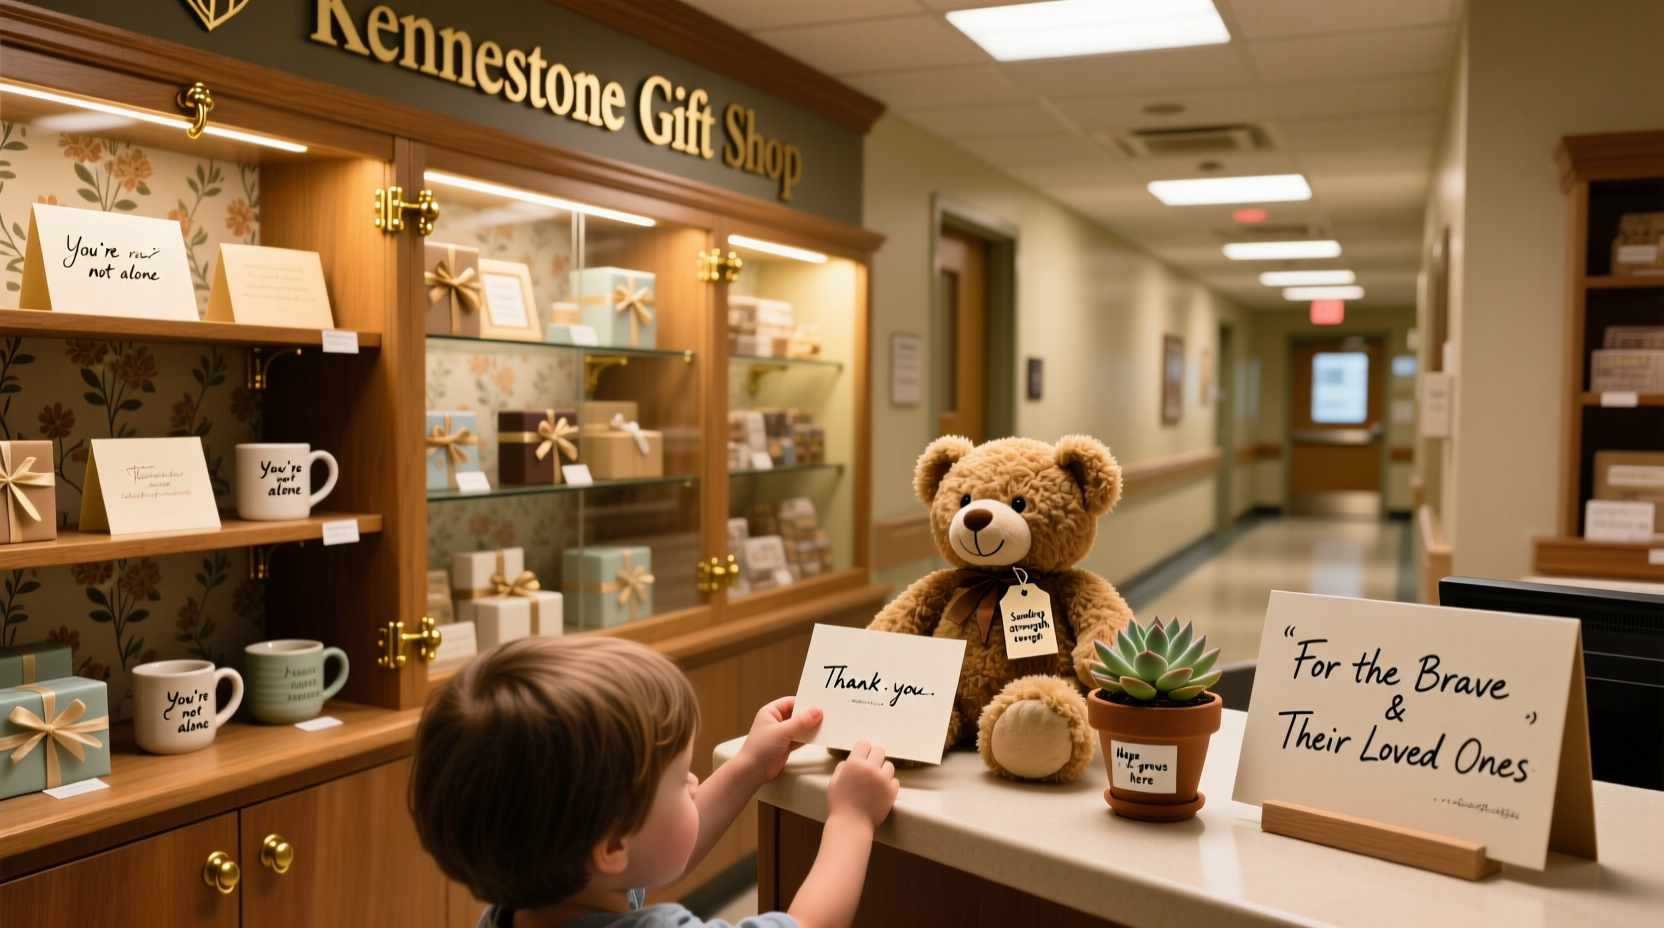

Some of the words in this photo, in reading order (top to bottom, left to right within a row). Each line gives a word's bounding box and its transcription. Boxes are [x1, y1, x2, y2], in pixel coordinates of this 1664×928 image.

[310, 0, 626, 131] Kennestone
[639, 75, 715, 160] Gift
[723, 102, 801, 200] Shop
[63, 234, 119, 268] You're
[89, 263, 115, 279] not
[120, 264, 160, 281] alone
[268, 482, 302, 496] alone
[1352, 647, 1401, 686] the
[1414, 654, 1509, 700] Brave
[163, 689, 209, 720] You're
[1384, 694, 1406, 722] &
[1278, 710, 1351, 754] Their
[1359, 724, 1446, 770] Loved
[1129, 771, 1154, 785] here
